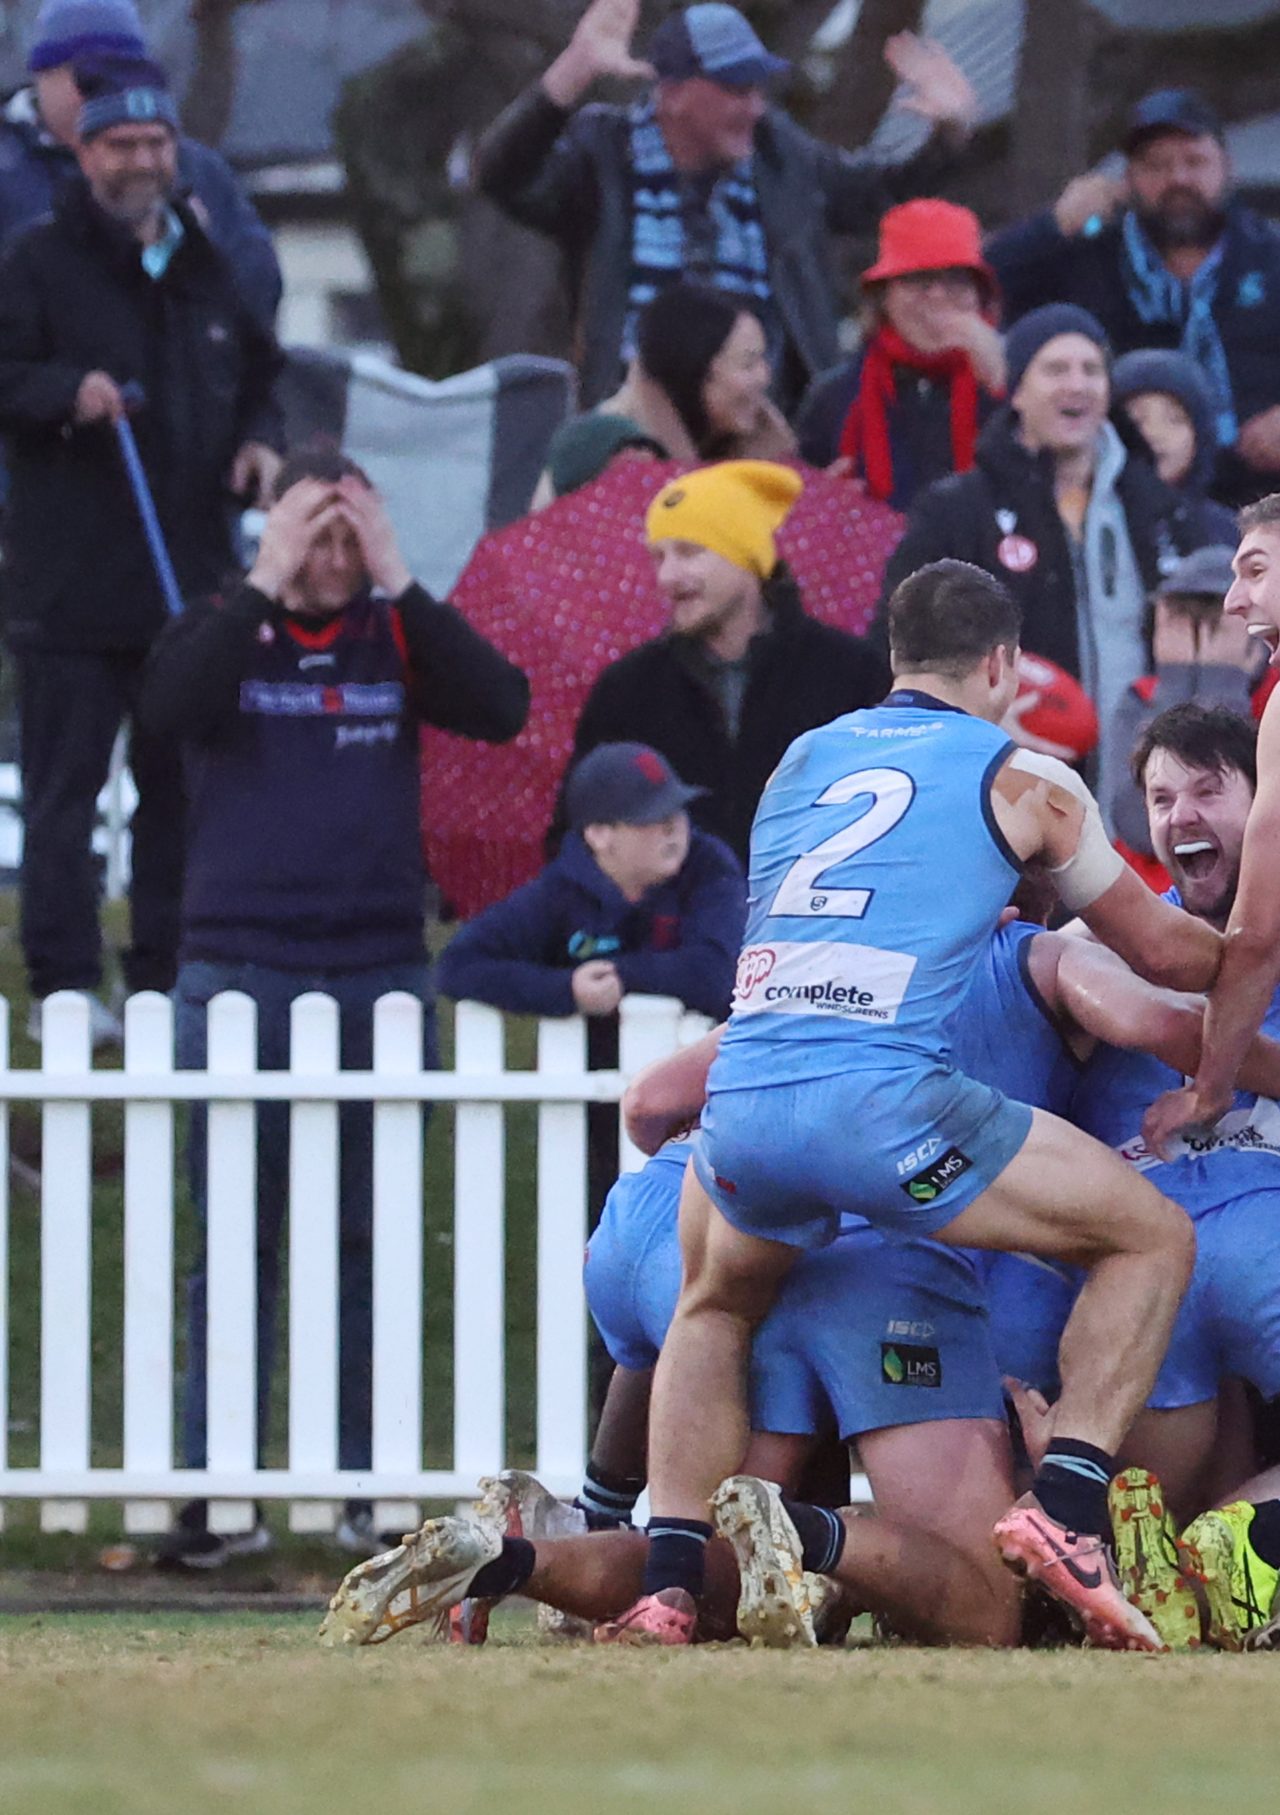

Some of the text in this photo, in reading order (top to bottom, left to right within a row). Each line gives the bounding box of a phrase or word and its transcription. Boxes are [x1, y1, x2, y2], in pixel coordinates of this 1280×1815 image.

[769, 767, 917, 919] 2
[764, 981, 874, 1006] complete
[815, 1002, 889, 1020] WINDSCREENS
[930, 1155, 963, 1184] LMS
[907, 1360, 937, 1378] LMS
